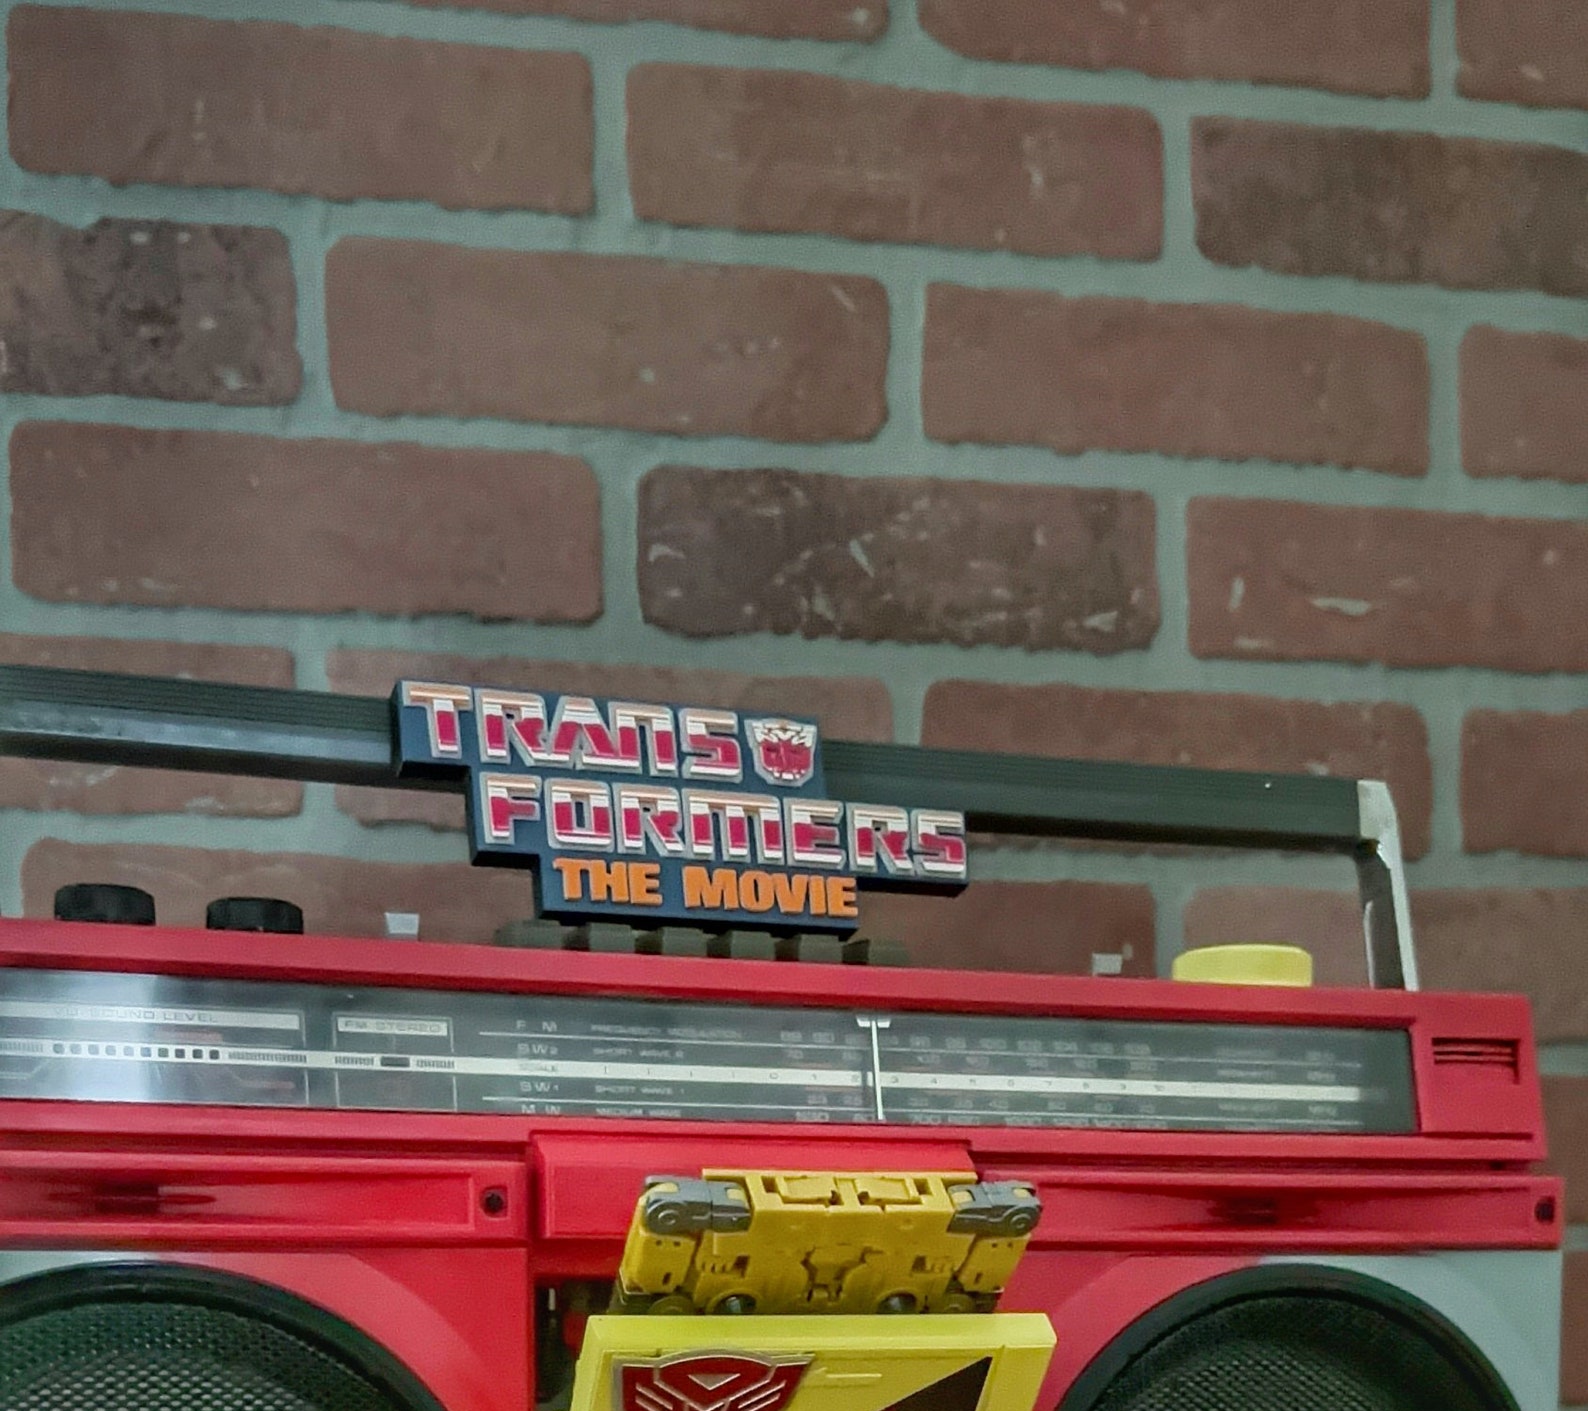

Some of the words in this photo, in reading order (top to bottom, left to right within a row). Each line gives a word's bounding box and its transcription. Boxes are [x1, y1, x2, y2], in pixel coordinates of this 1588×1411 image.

[402, 681, 744, 784] TRANS
[480, 772, 968, 878] FORMERS
[553, 858, 663, 906] THE
[682, 865, 859, 917] MOVIE
[162, 1013, 219, 1023] LEVEL
